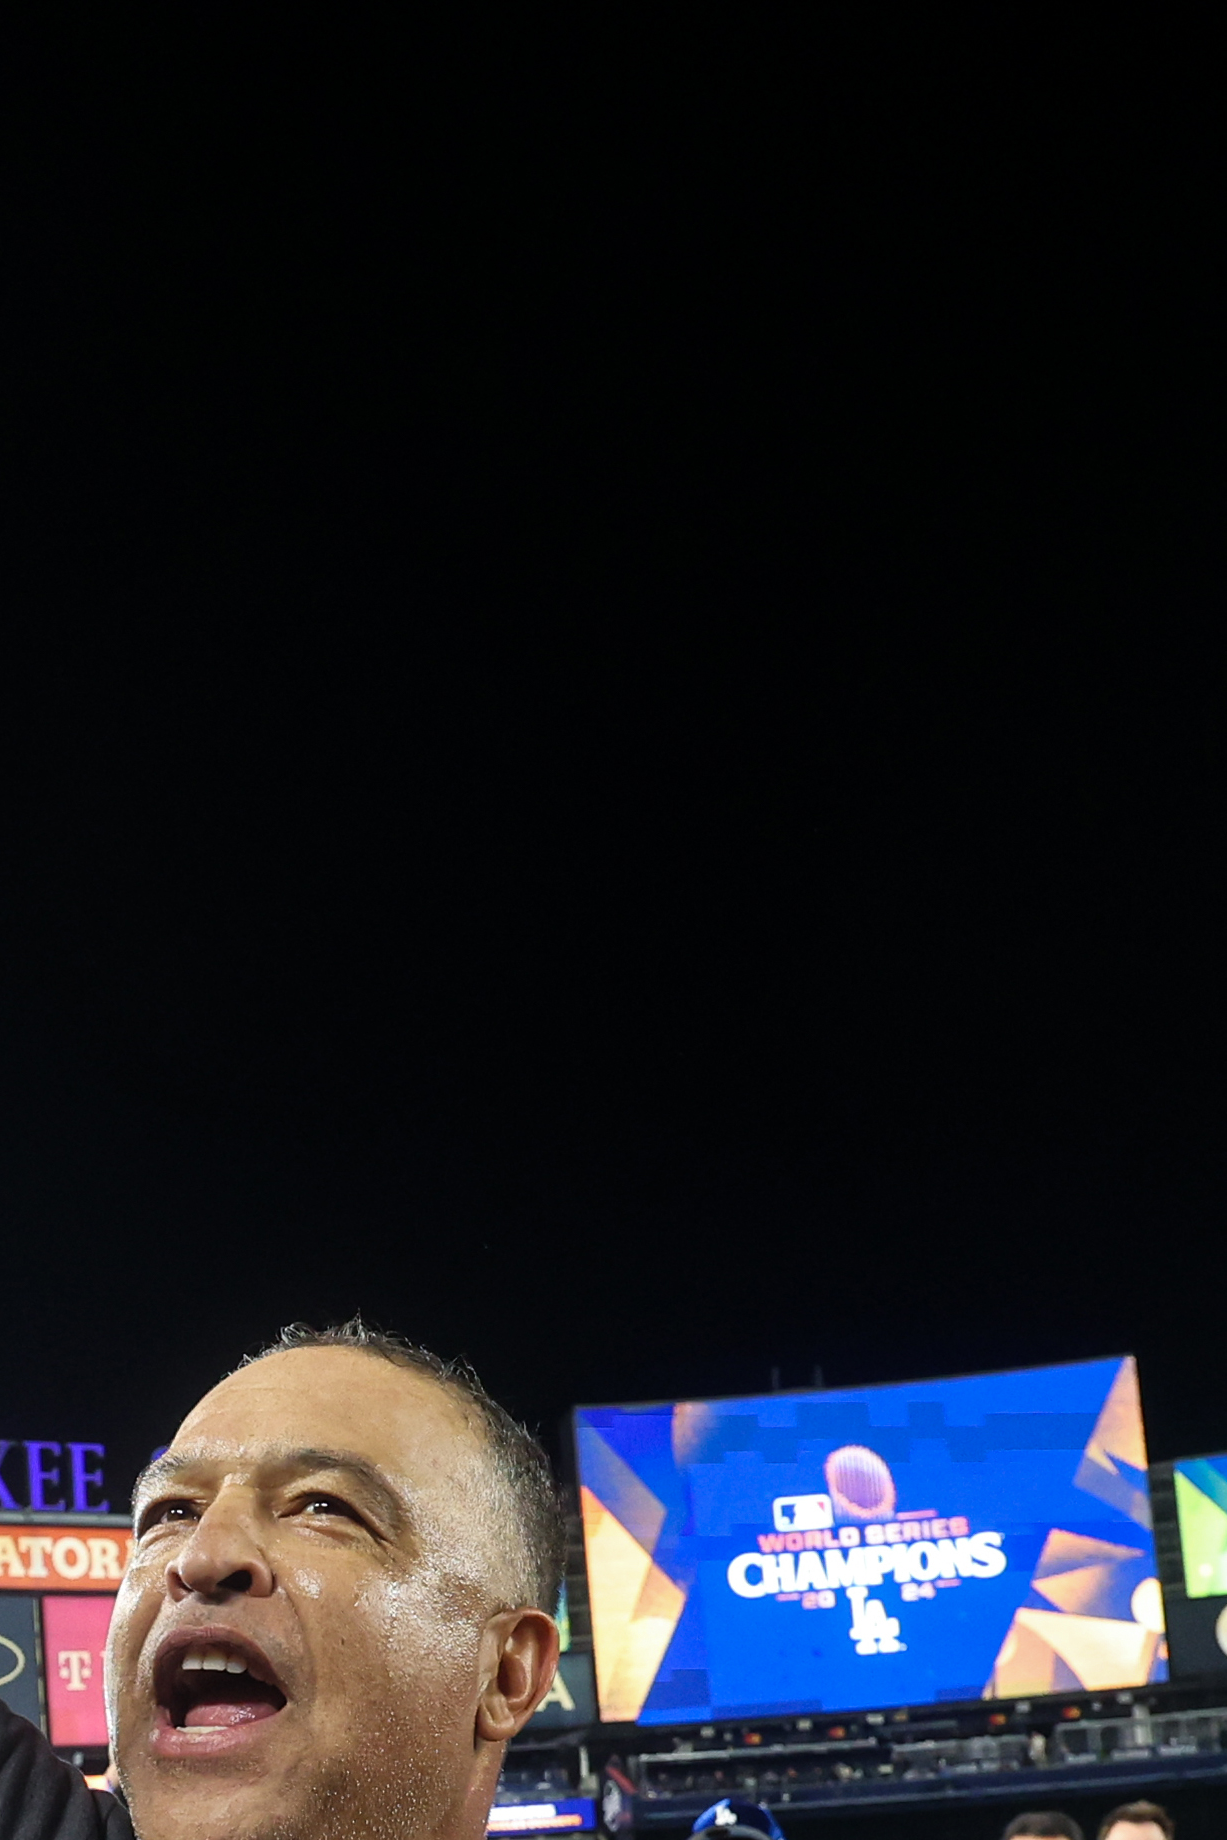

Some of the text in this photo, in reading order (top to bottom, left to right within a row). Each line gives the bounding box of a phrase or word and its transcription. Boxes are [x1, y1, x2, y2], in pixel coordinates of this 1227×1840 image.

[757, 1516, 969, 1553] WORLD SERIES
[727, 1531, 1007, 1598] CHAMPIONS
[801, 1582, 936, 1610] 20 24
[846, 1586, 901, 1655] LA
